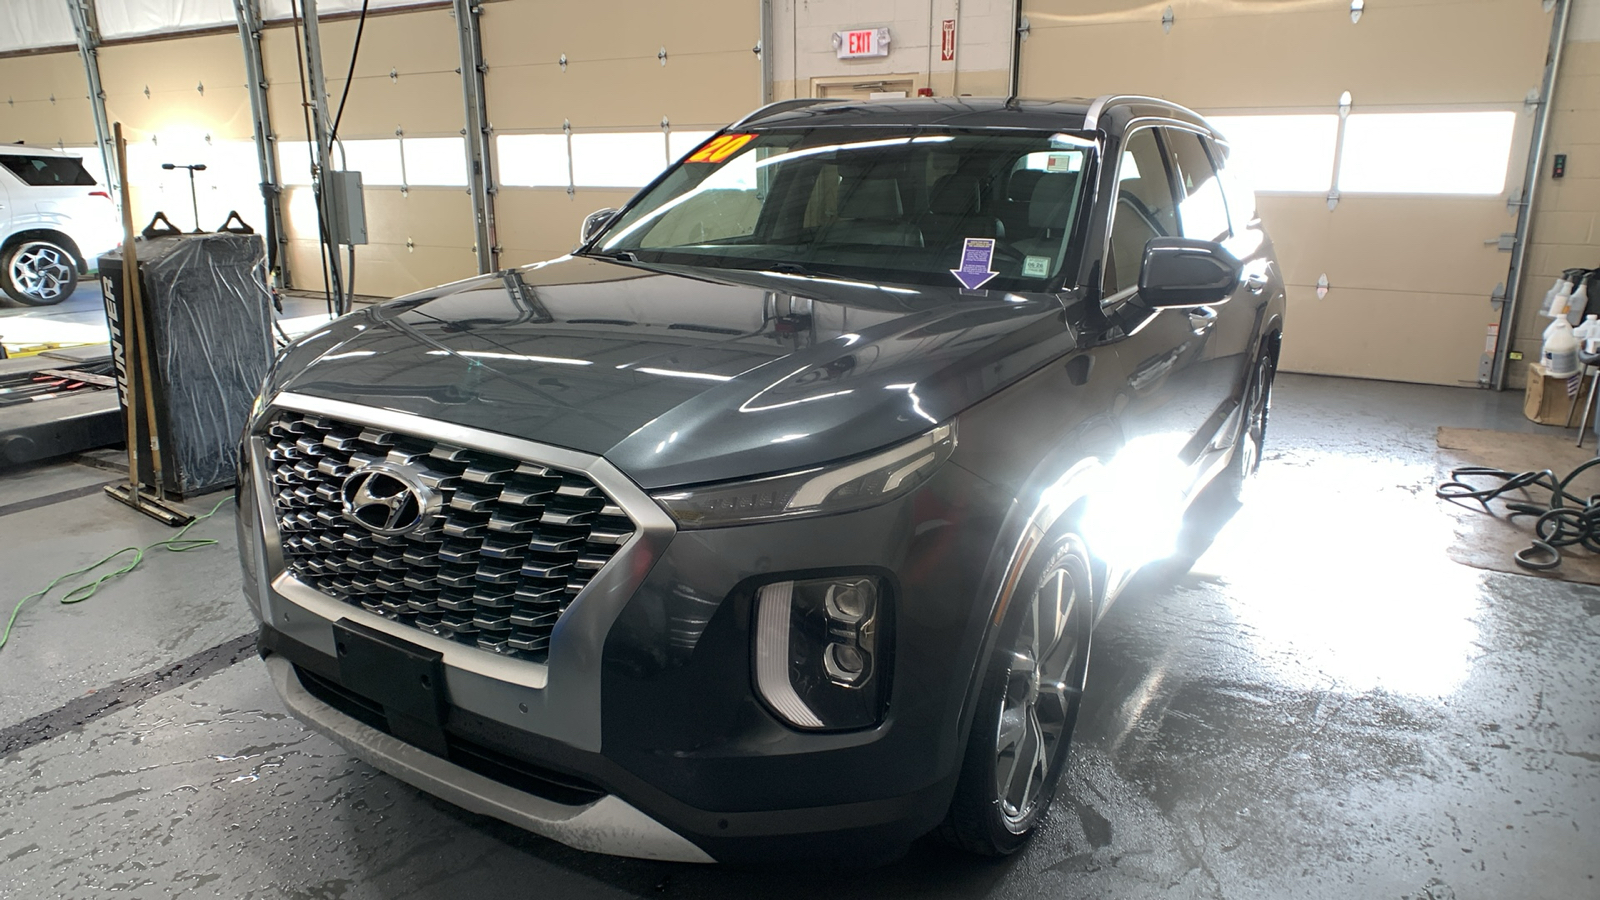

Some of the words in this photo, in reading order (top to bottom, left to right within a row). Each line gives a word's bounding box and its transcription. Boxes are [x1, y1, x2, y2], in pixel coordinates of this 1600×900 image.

[848, 31, 872, 54] EXIT
[689, 134, 752, 163] 20
[102, 275, 129, 407] HUNTER
